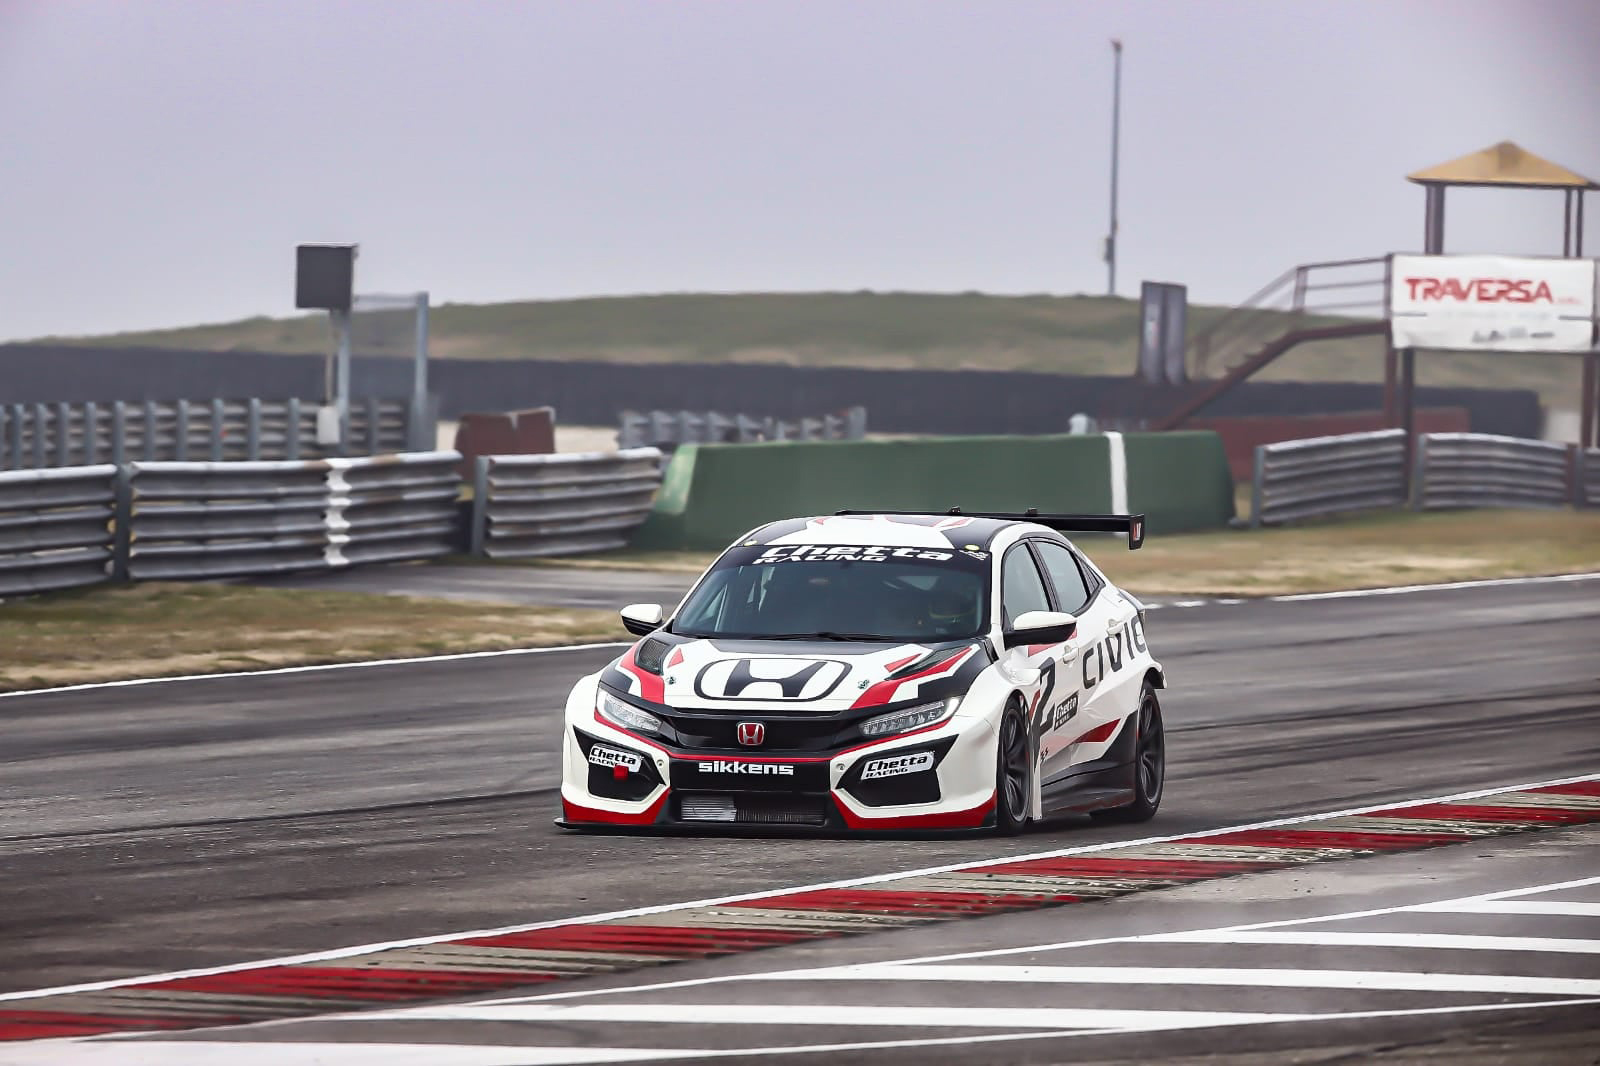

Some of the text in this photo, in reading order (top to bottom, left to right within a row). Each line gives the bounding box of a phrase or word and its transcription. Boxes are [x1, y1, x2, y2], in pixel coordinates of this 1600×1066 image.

[1405, 278, 1553, 304] TRAVERSA
[752, 554, 887, 564] RACING
[761, 545, 954, 560] Chetta
[590, 756, 618, 767] RACIN
[591, 747, 637, 765] Chetta
[699, 761, 794, 775] sikkens
[867, 756, 928, 772] Chetta
[865, 767, 909, 778] RACING
